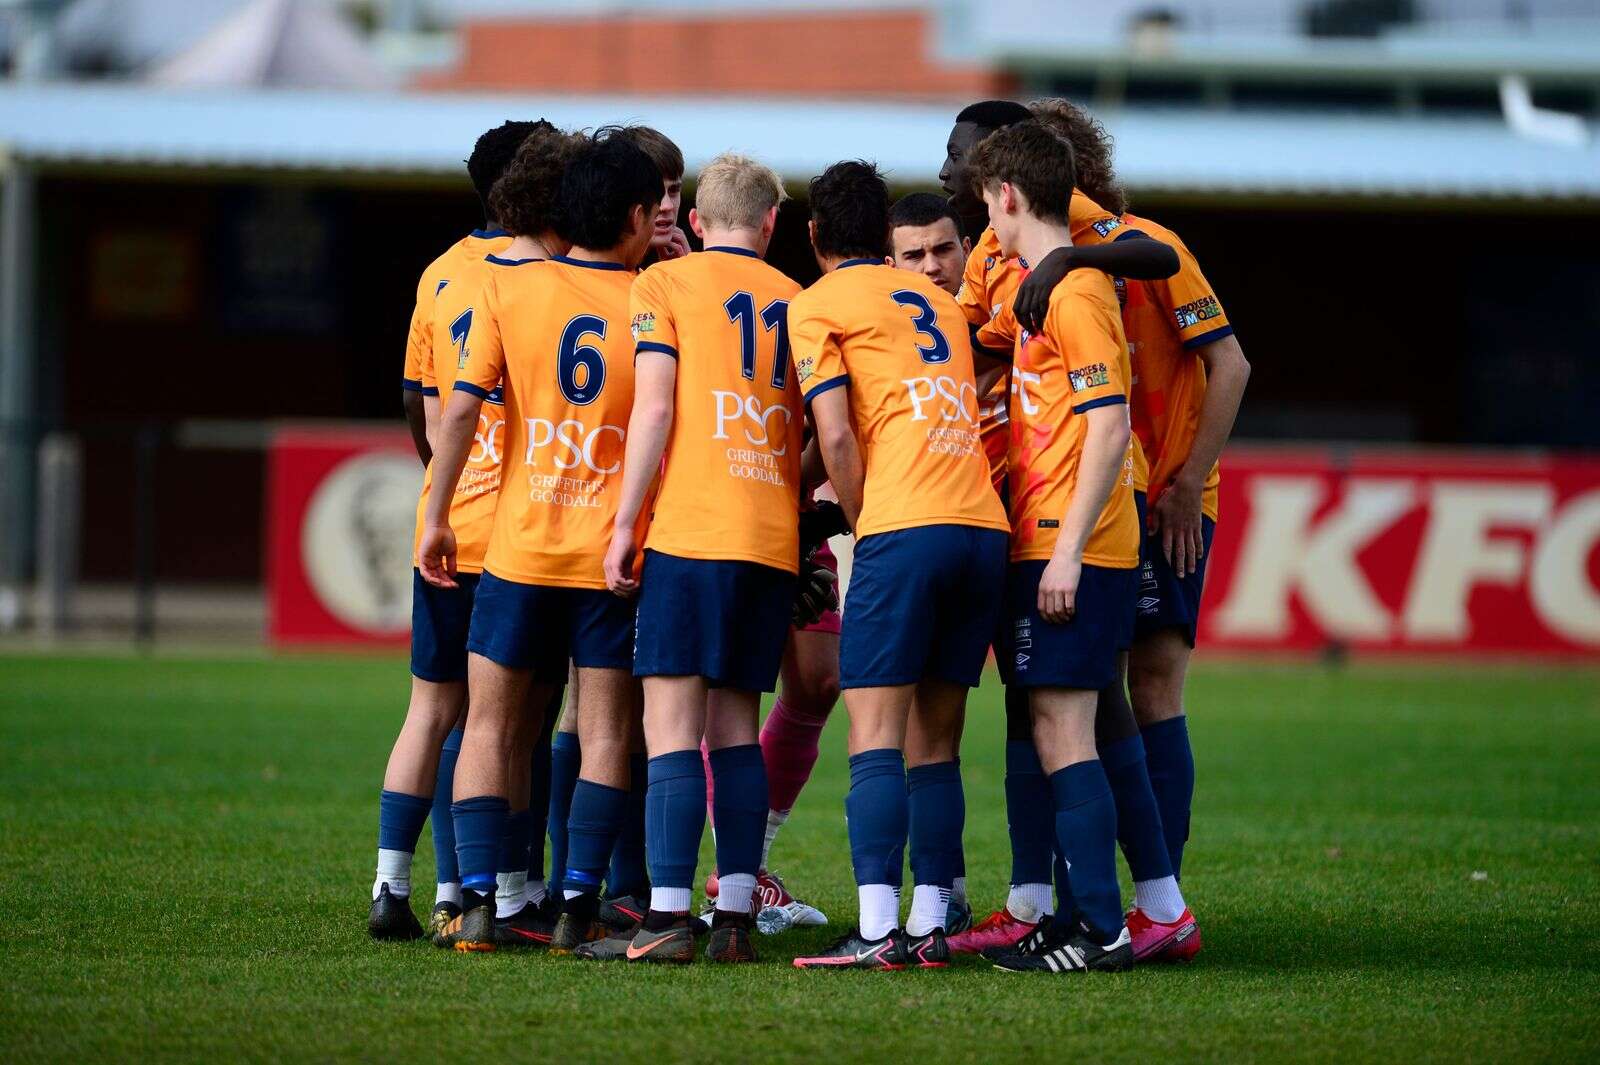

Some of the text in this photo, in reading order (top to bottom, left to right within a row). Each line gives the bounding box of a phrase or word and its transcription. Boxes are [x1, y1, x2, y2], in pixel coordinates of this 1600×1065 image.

[556, 313, 608, 406] 6
[723, 290, 791, 390] 11
[889, 288, 952, 365] 3
[712, 390, 792, 456] PSC
[900, 376, 981, 429] PSC
[525, 417, 625, 474] PSC
[530, 473, 606, 494] GRIFFITHS
[530, 488, 603, 508] GOODALL
[1213, 475, 1600, 646] KFC
